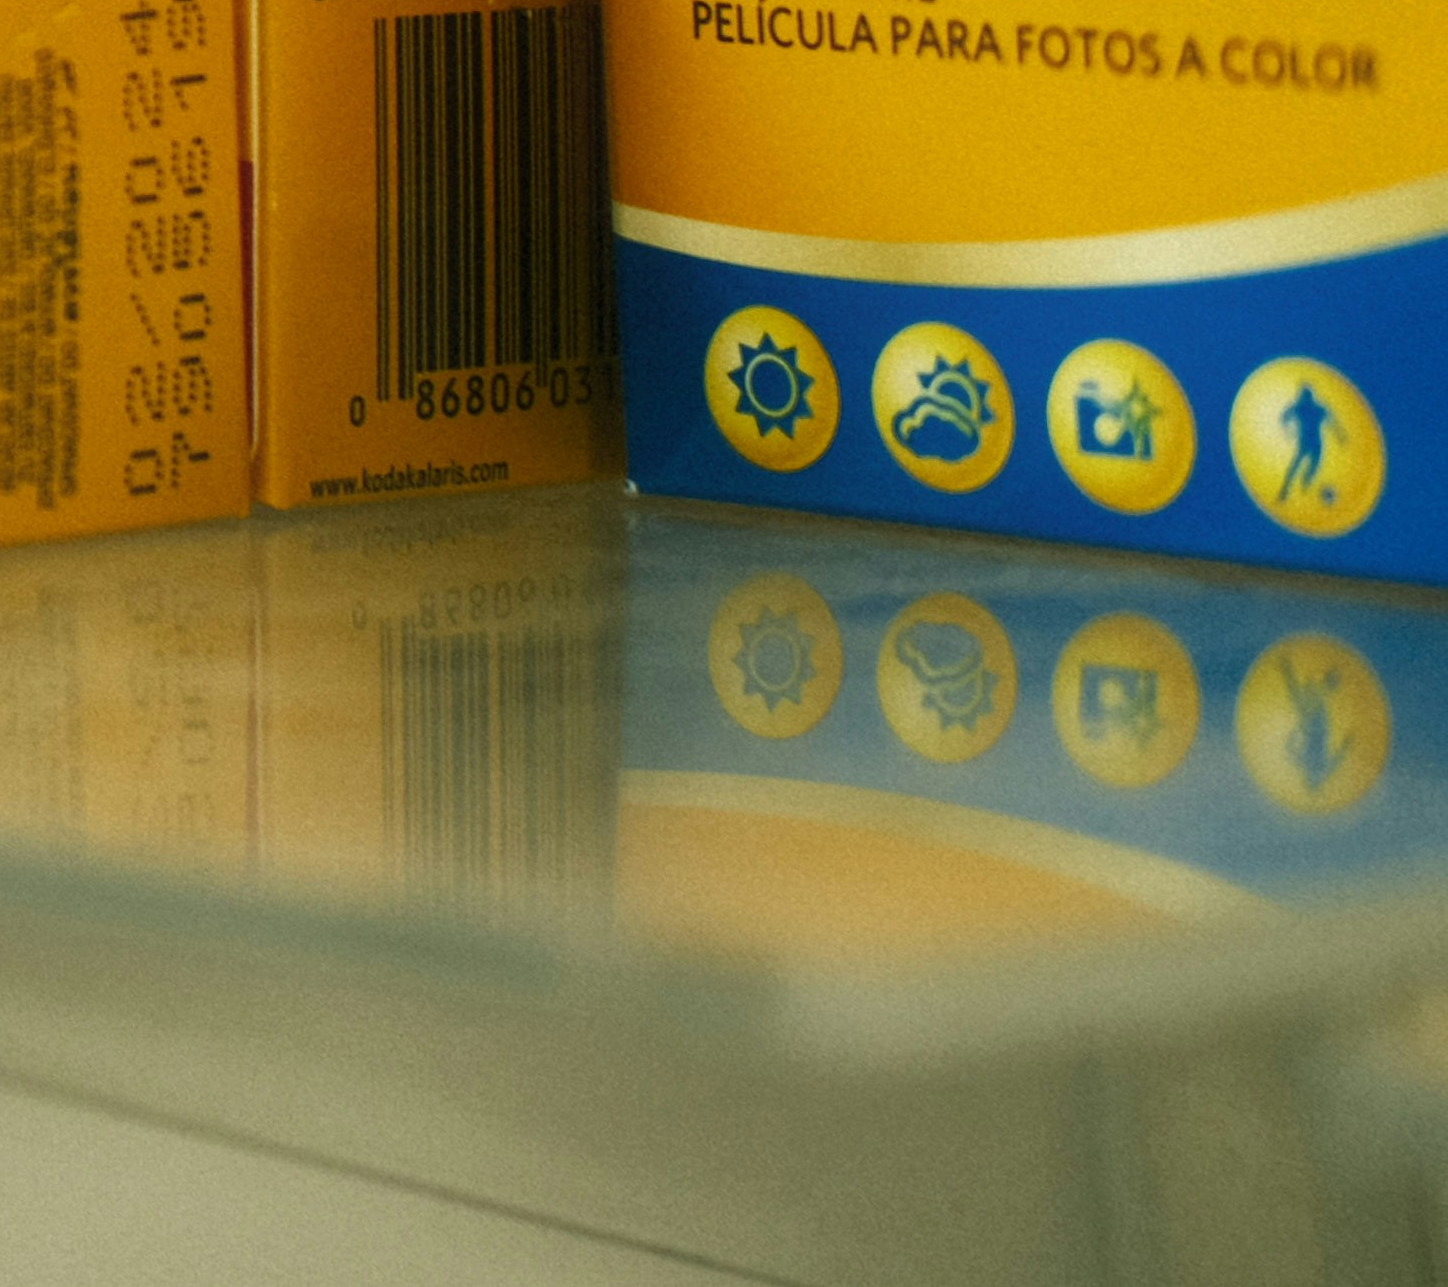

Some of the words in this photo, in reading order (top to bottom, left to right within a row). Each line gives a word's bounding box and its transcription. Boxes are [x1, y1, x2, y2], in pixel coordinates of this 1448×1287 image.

[890, 15, 1003, 64] PARA
[1016, 24, 1162, 79] FOTOS
[1174, 34, 1207, 81] A
[1219, 36, 1379, 95] COLOR
[118, 0, 166, 497] 02/2024
[348, 394, 366, 427] 0
[415, 370, 535, 421] 86806
[308, 459, 510, 498] www.kodakalaris.com
